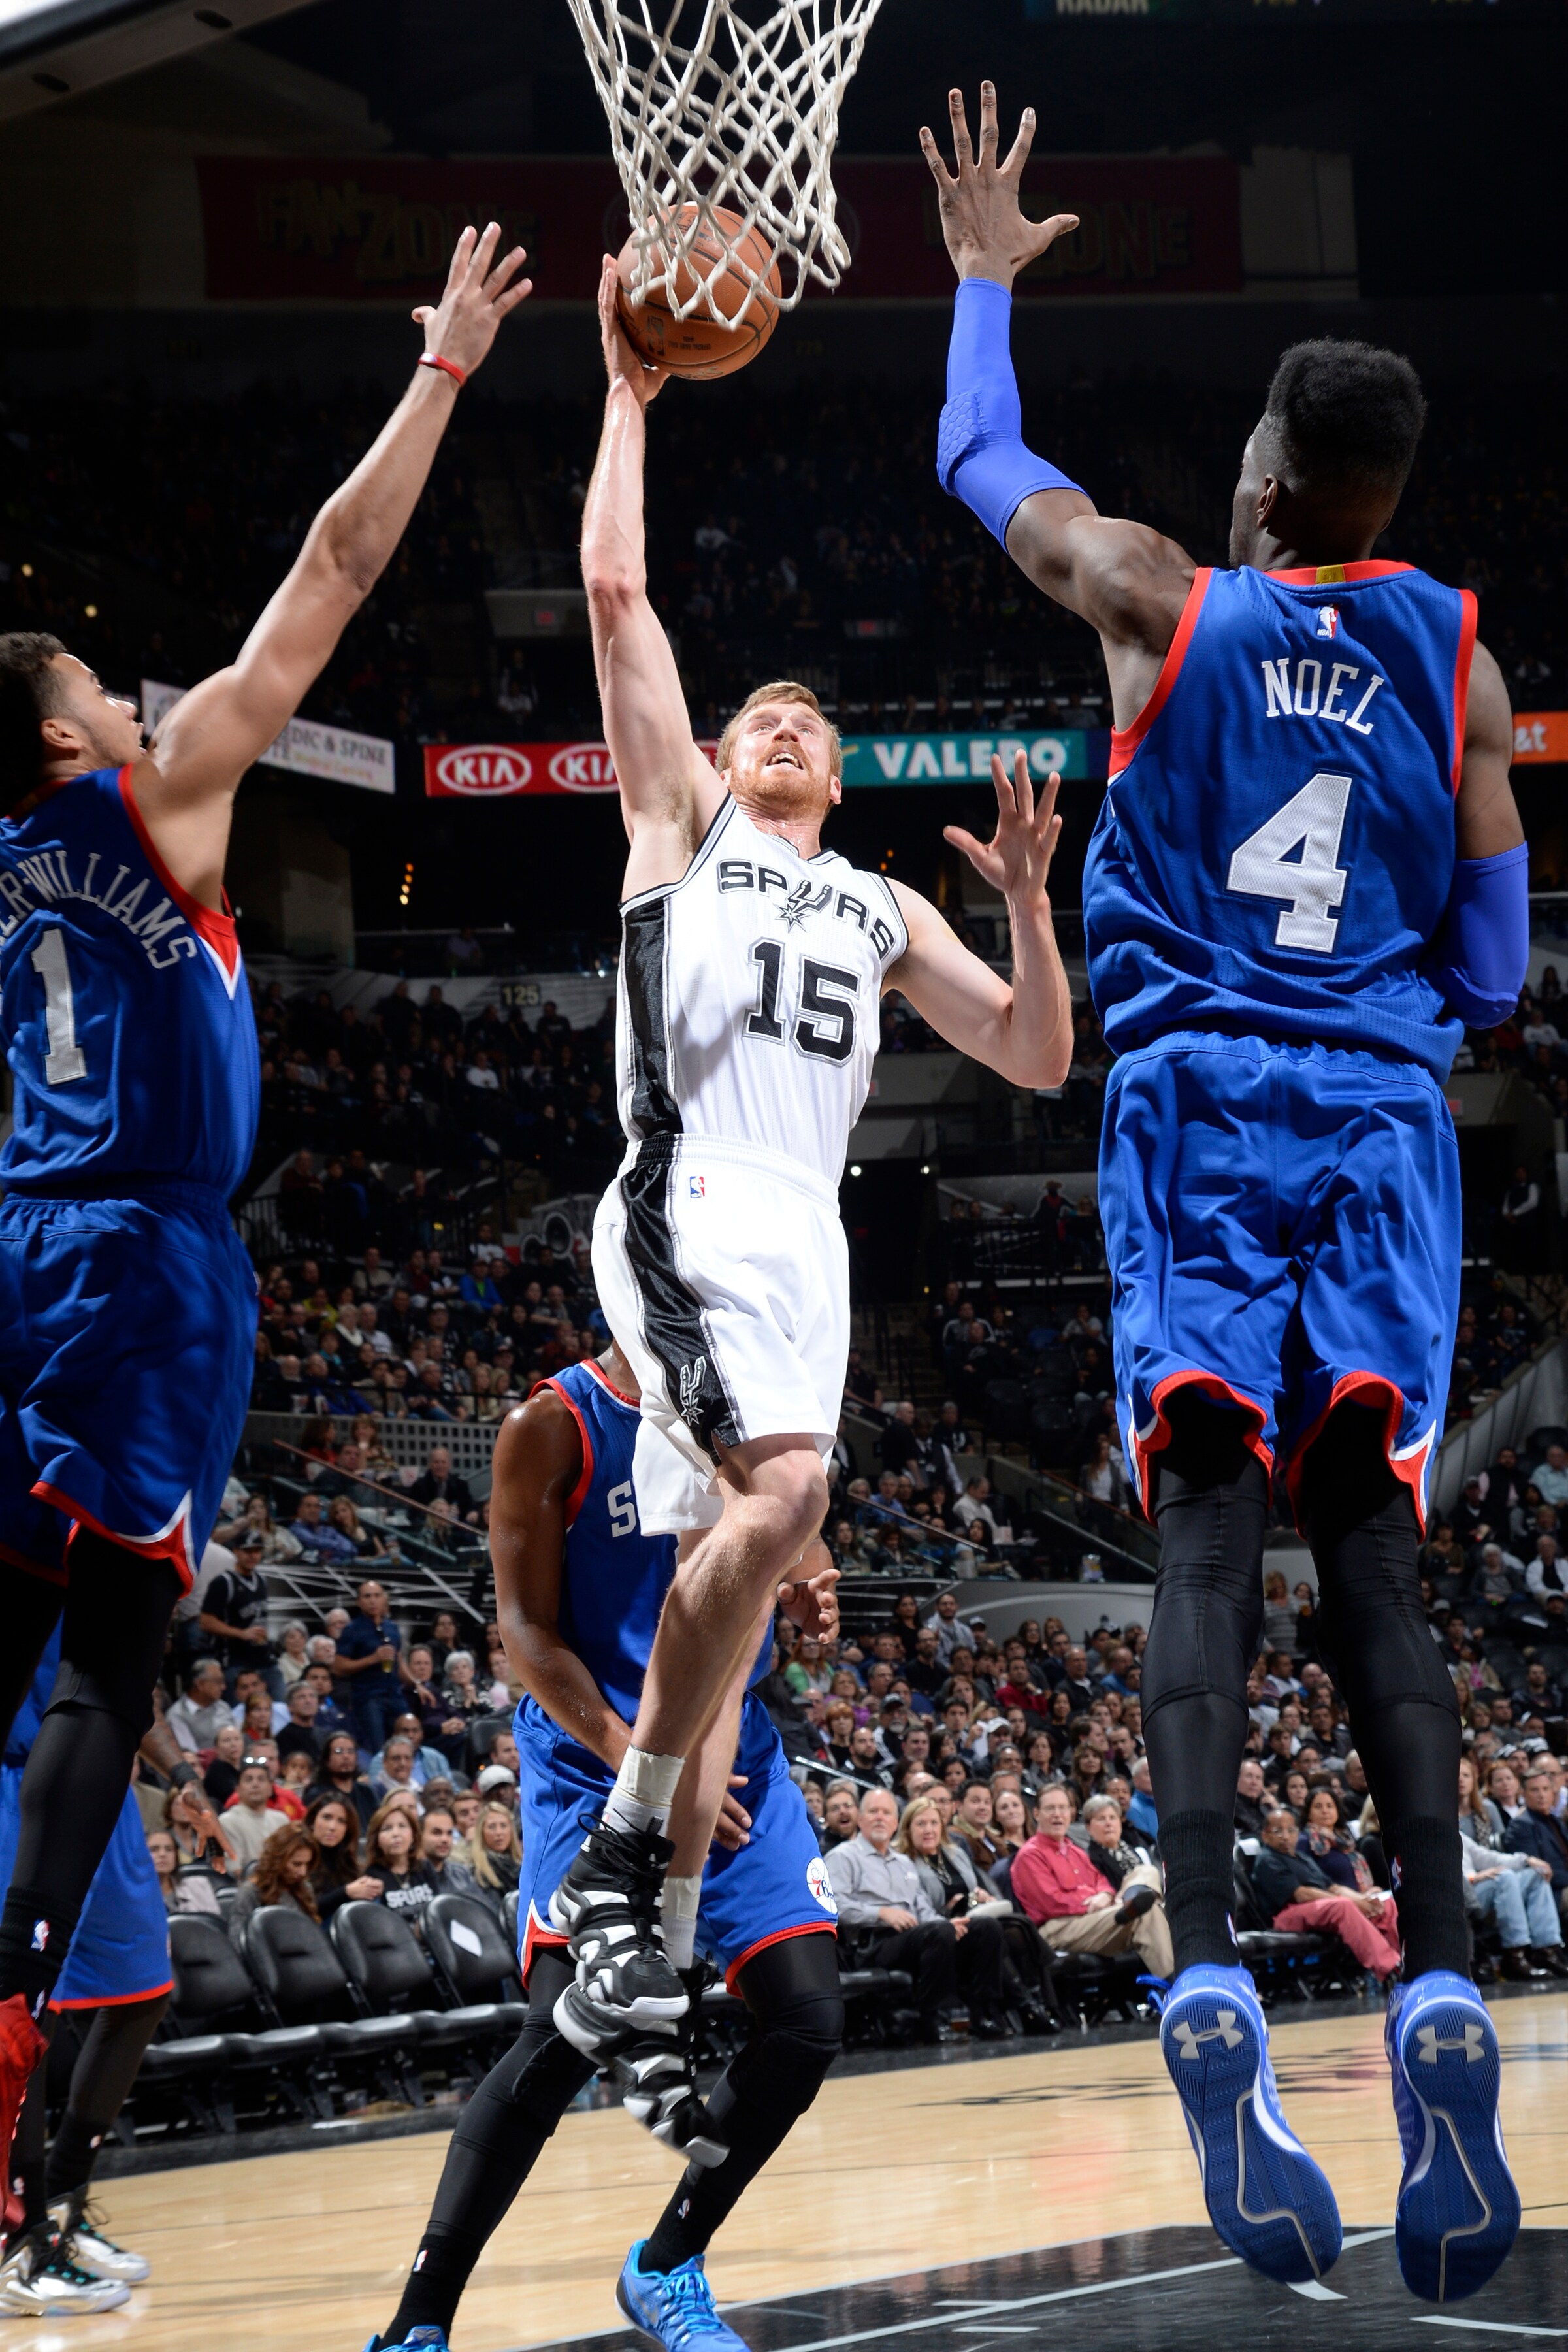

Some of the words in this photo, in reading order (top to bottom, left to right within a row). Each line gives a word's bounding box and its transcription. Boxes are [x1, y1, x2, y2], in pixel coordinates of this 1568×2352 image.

[1261, 657, 1384, 735] NOEL
[455, 756, 517, 785] KIA
[872, 738, 1068, 779] VALERO
[1226, 773, 1352, 953] 4
[717, 858, 895, 960] SPURS
[31, 928, 87, 1085] 1
[502, 985, 539, 1005] 125
[742, 937, 862, 1068] 15
[607, 1478, 636, 1537] S
[385, 1883, 434, 1908] SPURS
